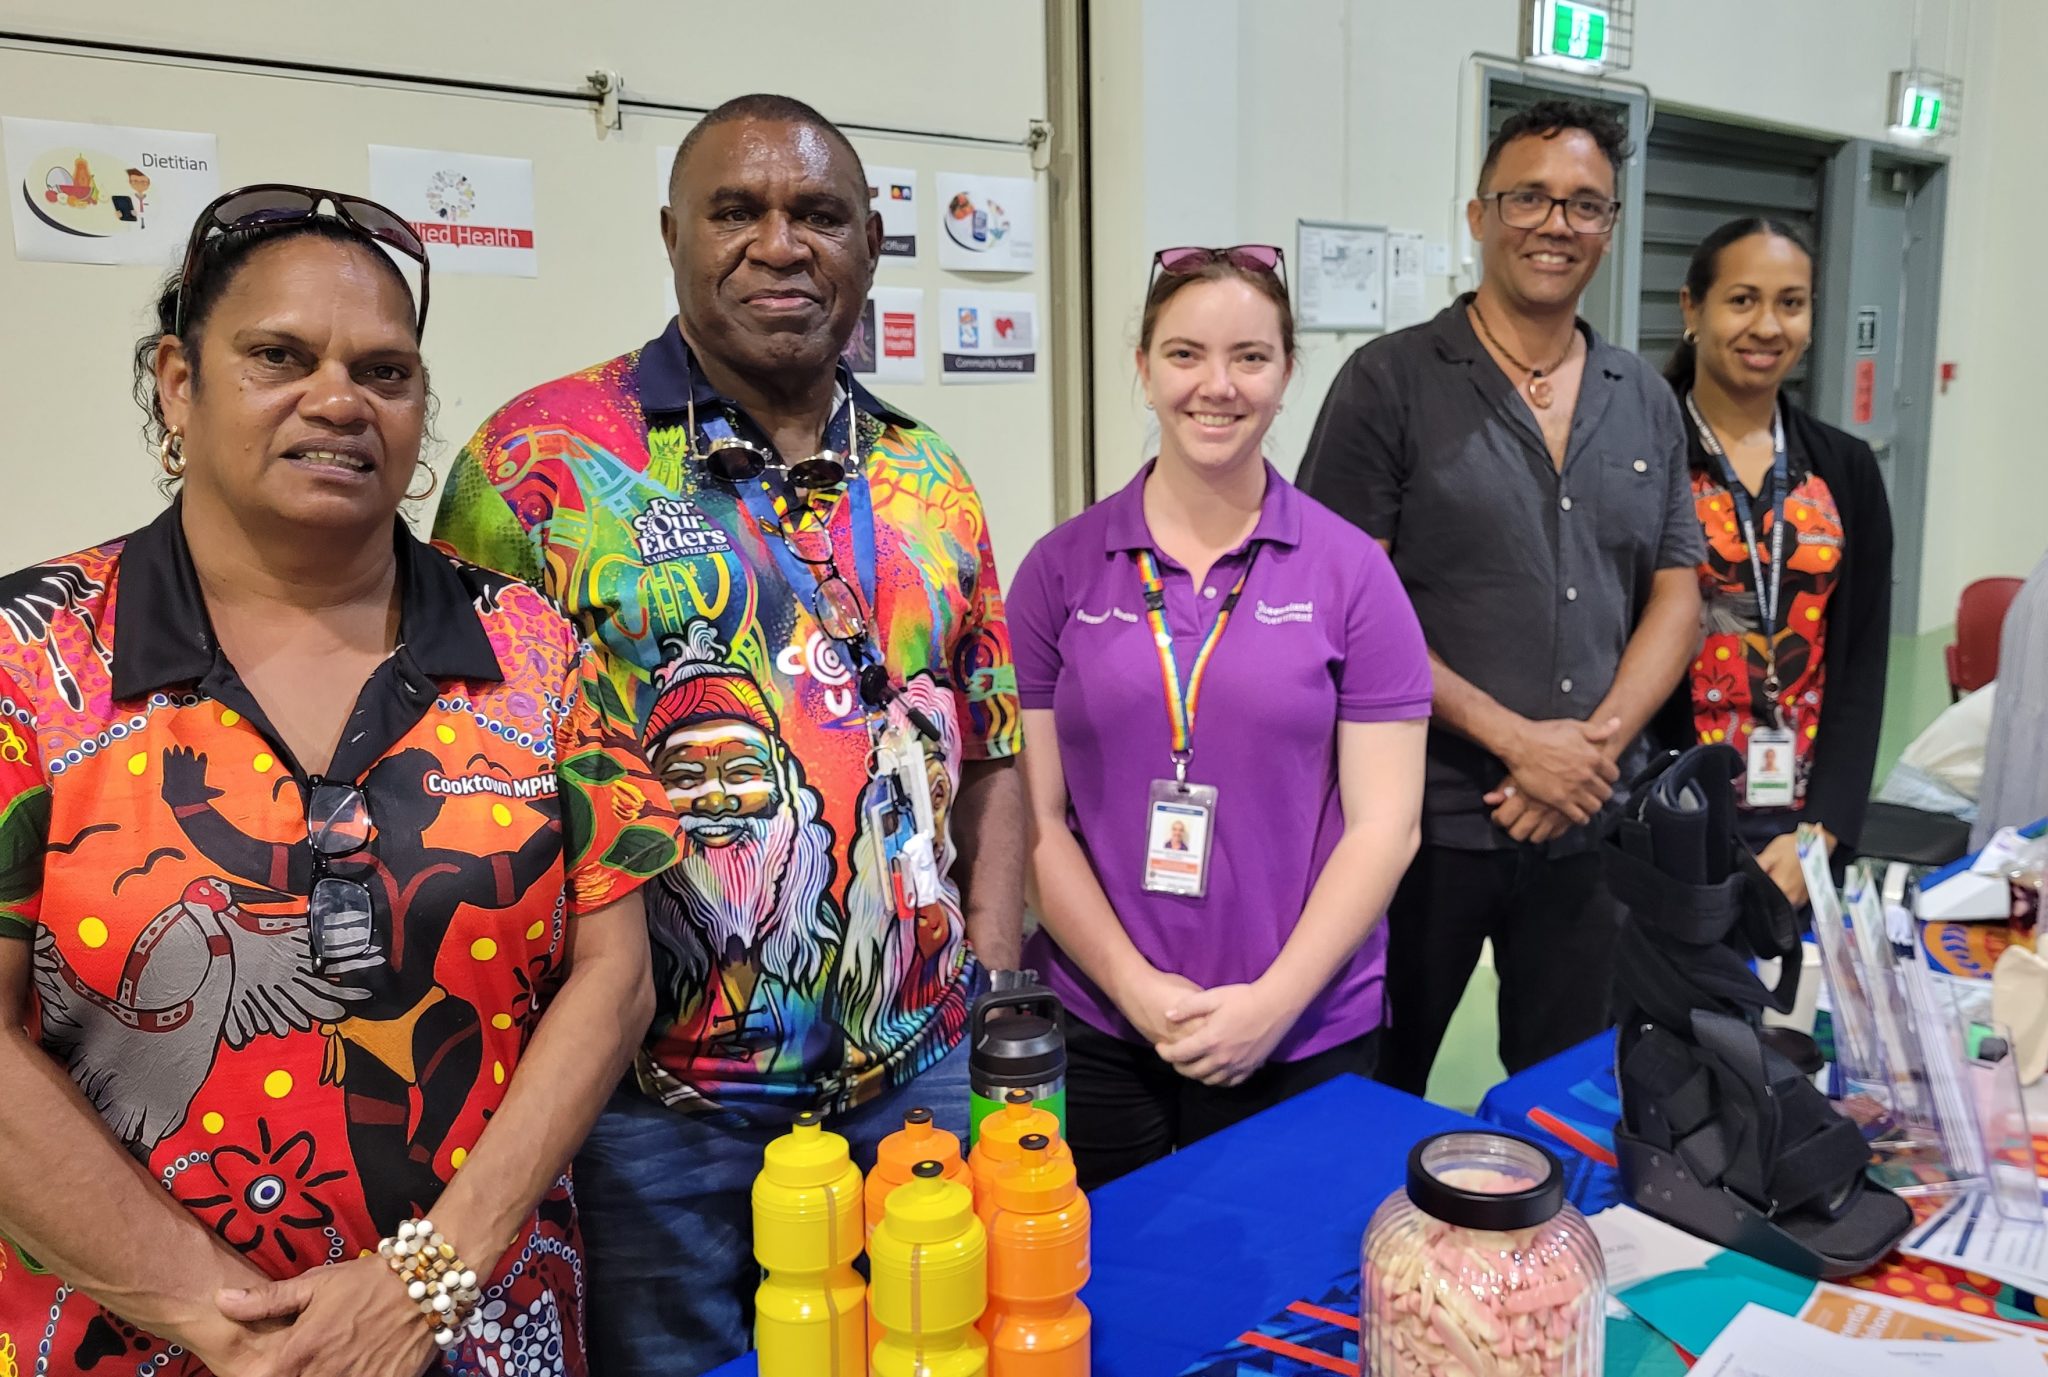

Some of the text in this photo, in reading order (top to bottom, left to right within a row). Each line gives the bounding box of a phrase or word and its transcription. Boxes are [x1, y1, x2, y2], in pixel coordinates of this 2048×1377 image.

[142, 153, 208, 171] Dietitian
[411, 222, 520, 247] llied Health
[650, 498, 694, 516] For
[651, 514, 705, 535] Our
[639, 530, 728, 557] Elders
[680, 545, 706, 555] WEEK
[428, 774, 512, 797] Cooktown
